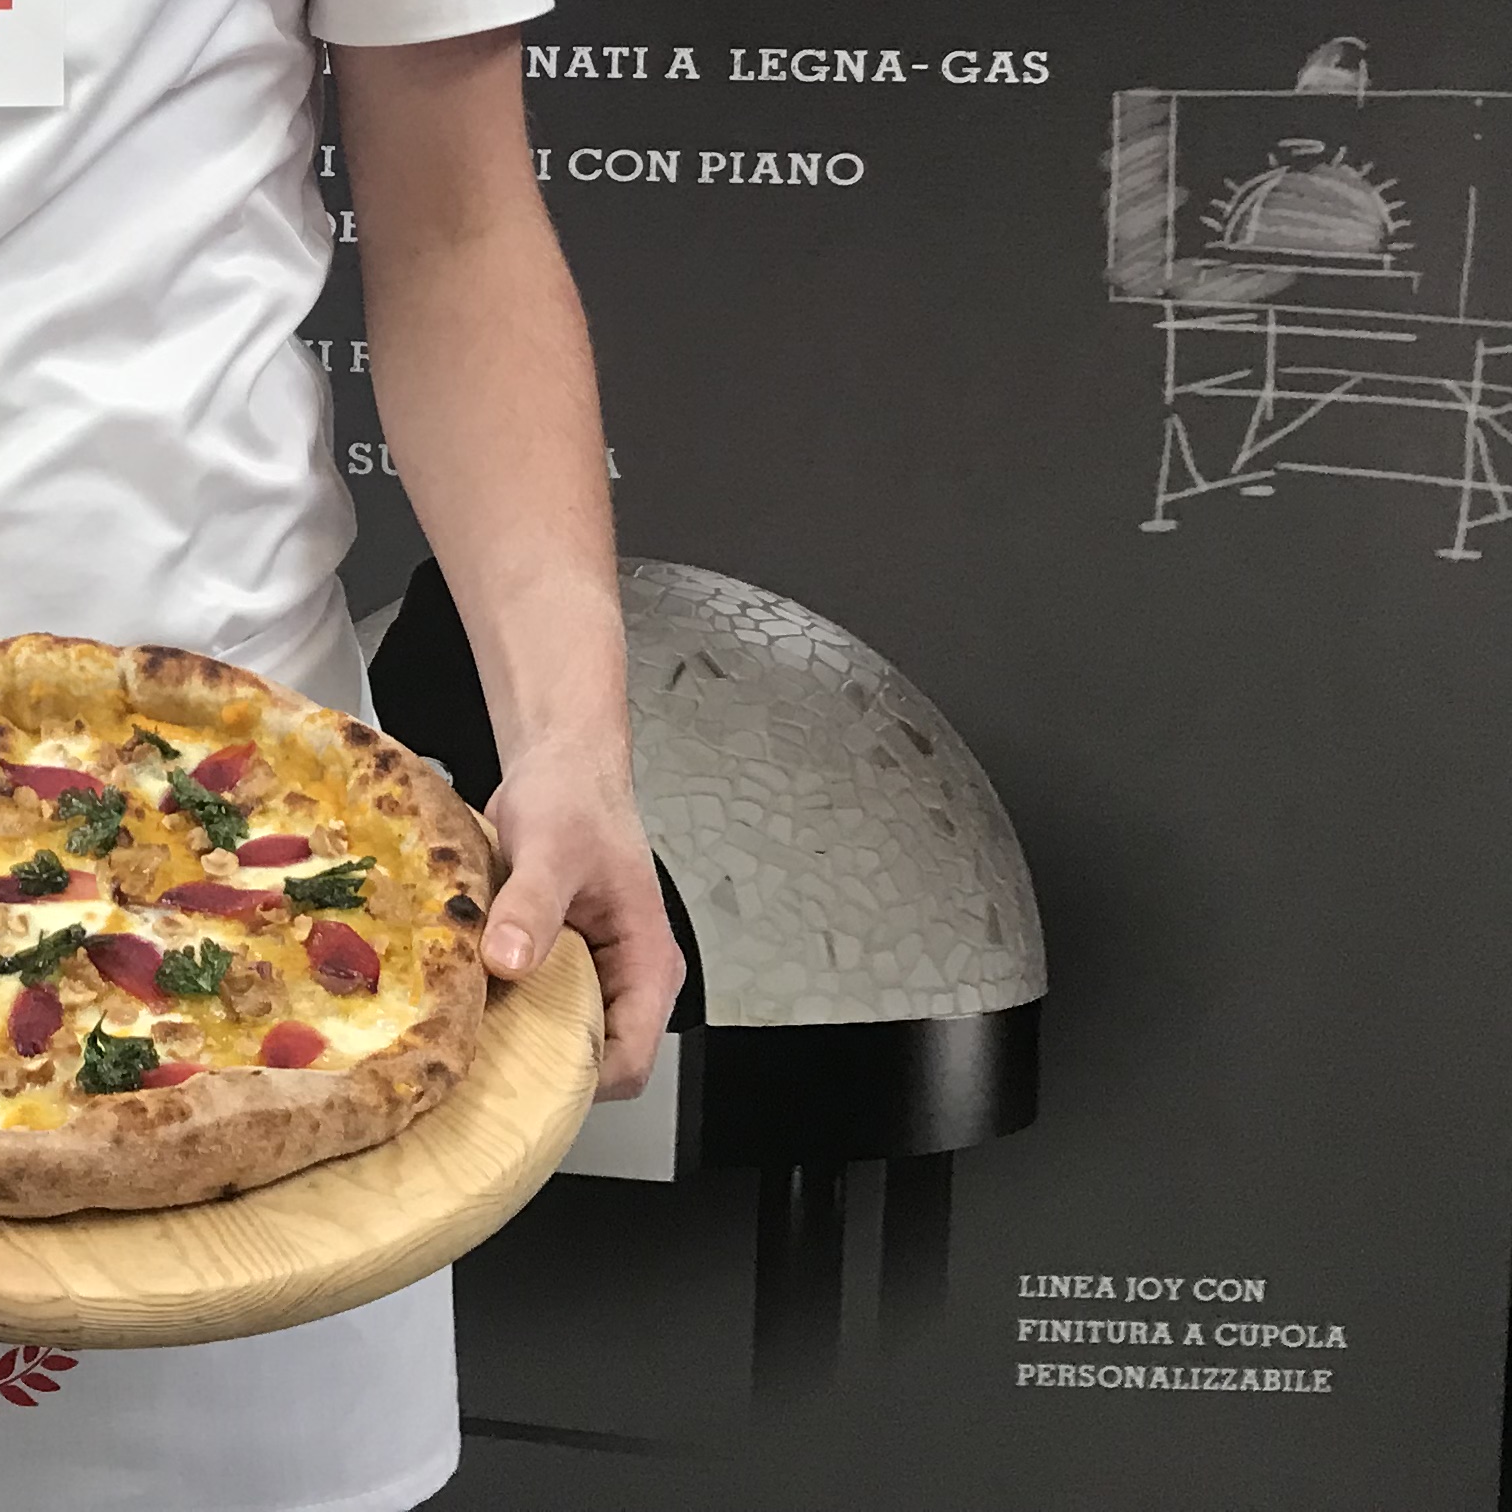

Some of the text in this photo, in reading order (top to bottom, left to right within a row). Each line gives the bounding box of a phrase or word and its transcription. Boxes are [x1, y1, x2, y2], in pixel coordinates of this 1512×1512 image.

[664, 47, 701, 80] A
[567, 148, 681, 184] CON
[697, 151, 865, 186] PIANO
[1017, 1274, 1266, 1303] LINEA JOY CON
[1017, 1318, 1348, 1349] FINITURA A CUPOLA
[1015, 1362, 1334, 1393] PERSONALIZZABILE
